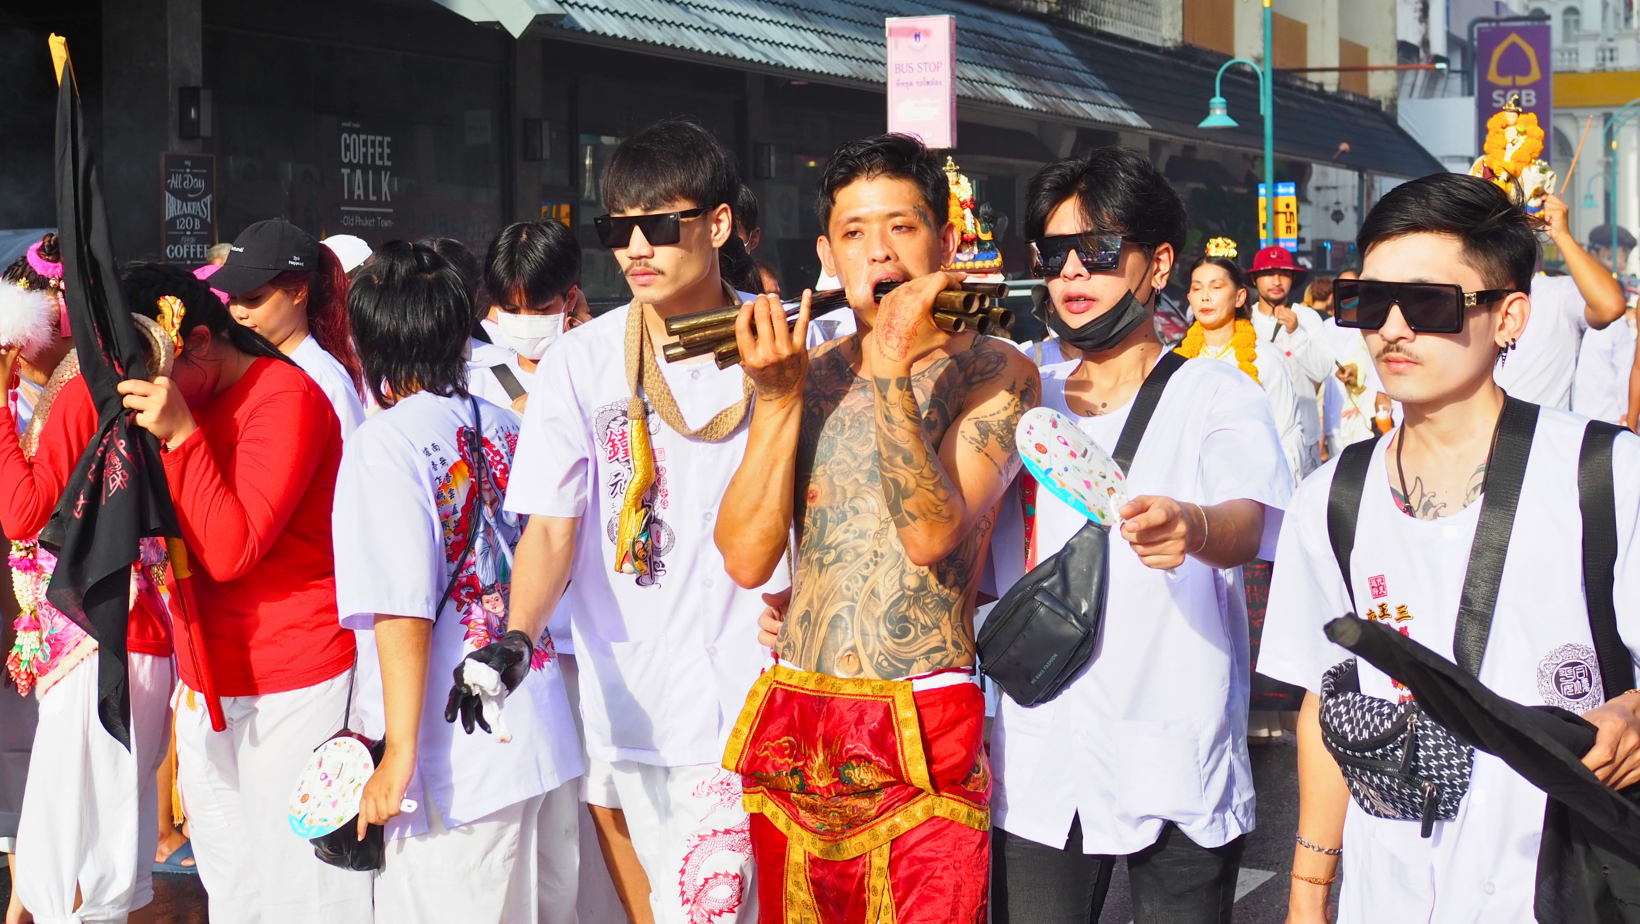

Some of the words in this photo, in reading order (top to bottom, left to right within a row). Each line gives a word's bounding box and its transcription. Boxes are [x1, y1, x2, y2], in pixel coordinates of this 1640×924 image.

[895, 62, 914, 74] BUS
[917, 61, 943, 73] STOP
[341, 133, 392, 166] COFFEE
[167, 173, 182, 189] All
[183, 174, 205, 197] Day
[341, 168, 392, 202] TALK
[165, 190, 212, 224] BREAKFAST
[176, 217, 193, 230] 120
[195, 219, 201, 230] B
[355, 215, 375, 227] Phuket
[166, 244, 210, 259] COFFEE
[1043, 653, 1058, 669] FASHION
